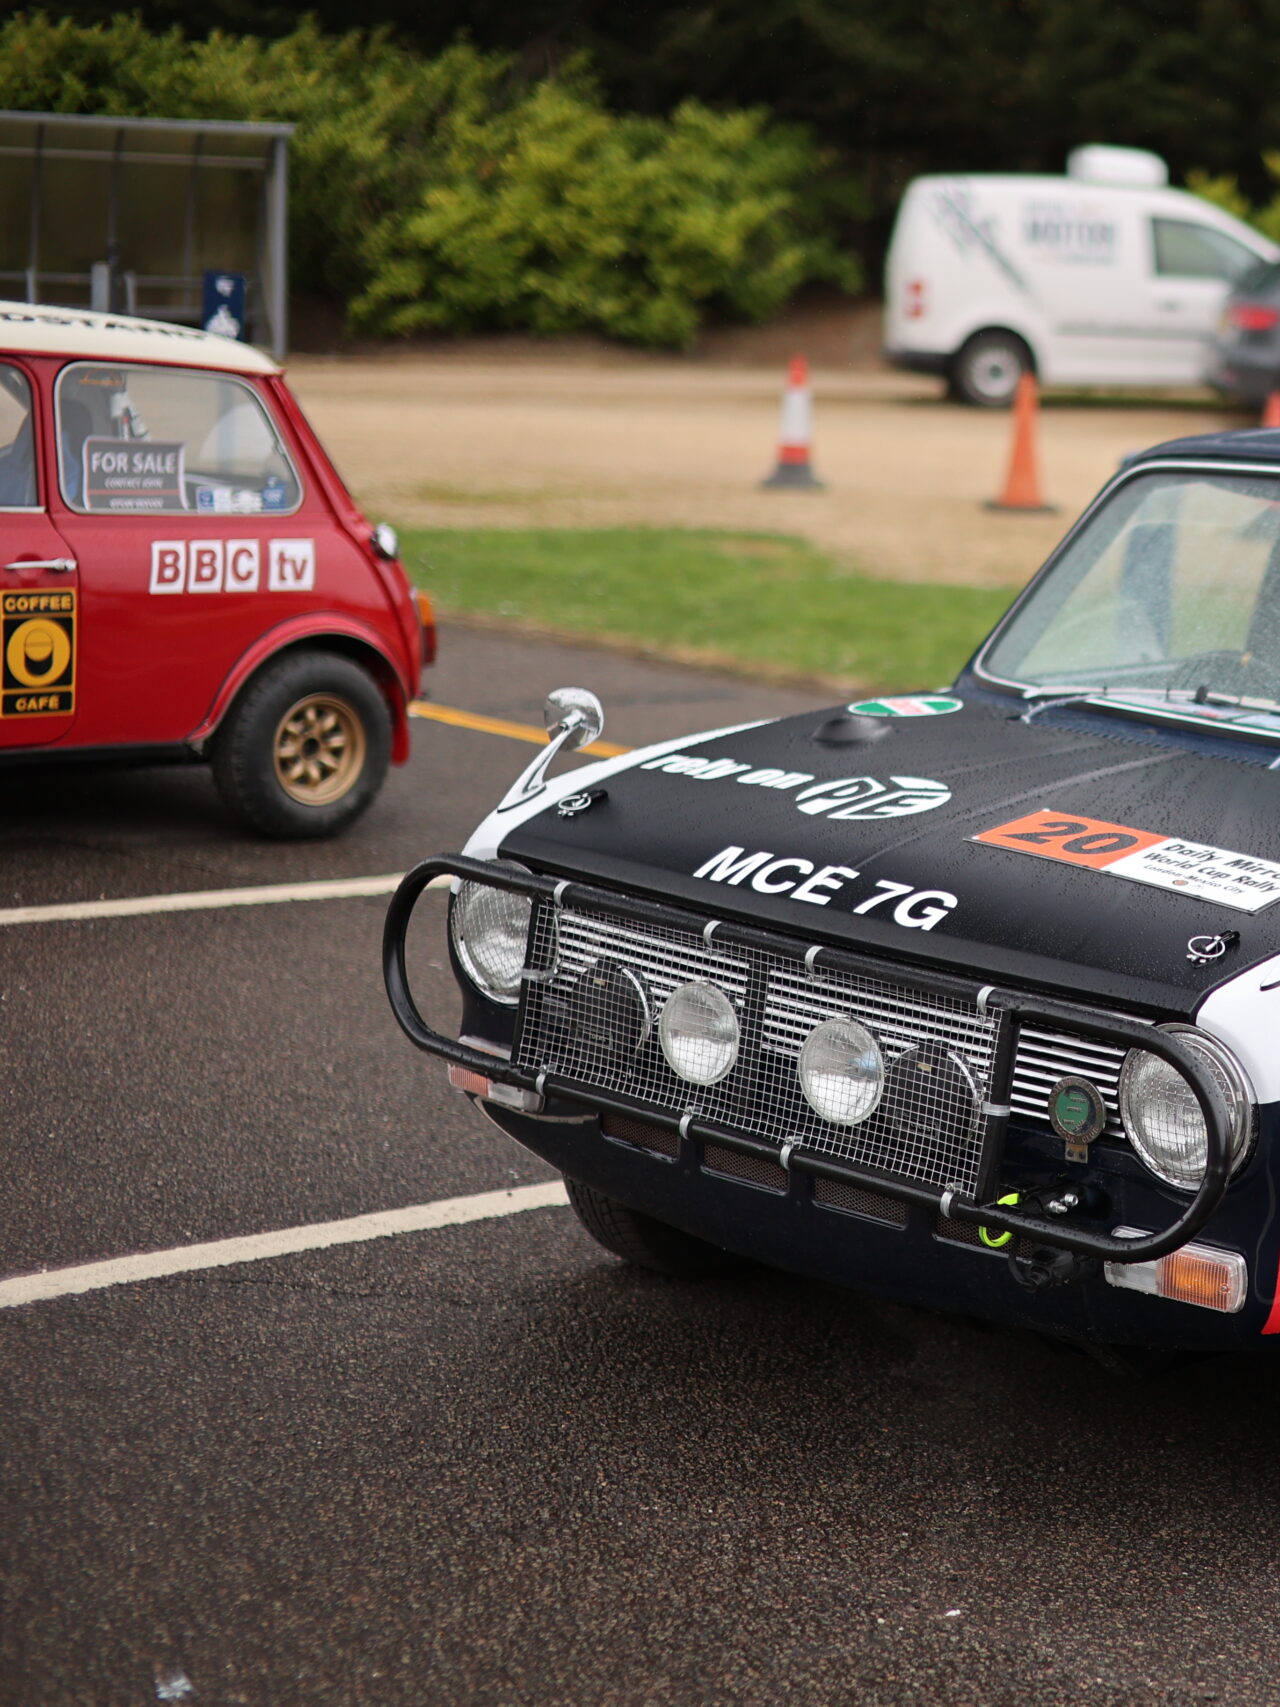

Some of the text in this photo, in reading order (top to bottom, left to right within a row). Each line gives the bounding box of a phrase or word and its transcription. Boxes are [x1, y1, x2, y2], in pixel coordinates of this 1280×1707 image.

[92, 452, 176, 473] FOR SALE
[155, 547, 309, 586] BBC tv
[5, 595, 73, 612] COFFEE
[640, 754, 752, 780] rely
[737, 769, 815, 789] on
[1002, 821, 1140, 855] 20
[1162, 843, 1223, 862] Daily
[693, 846, 958, 931] MCE 7G
[1143, 852, 1280, 893] World Cup Rally
